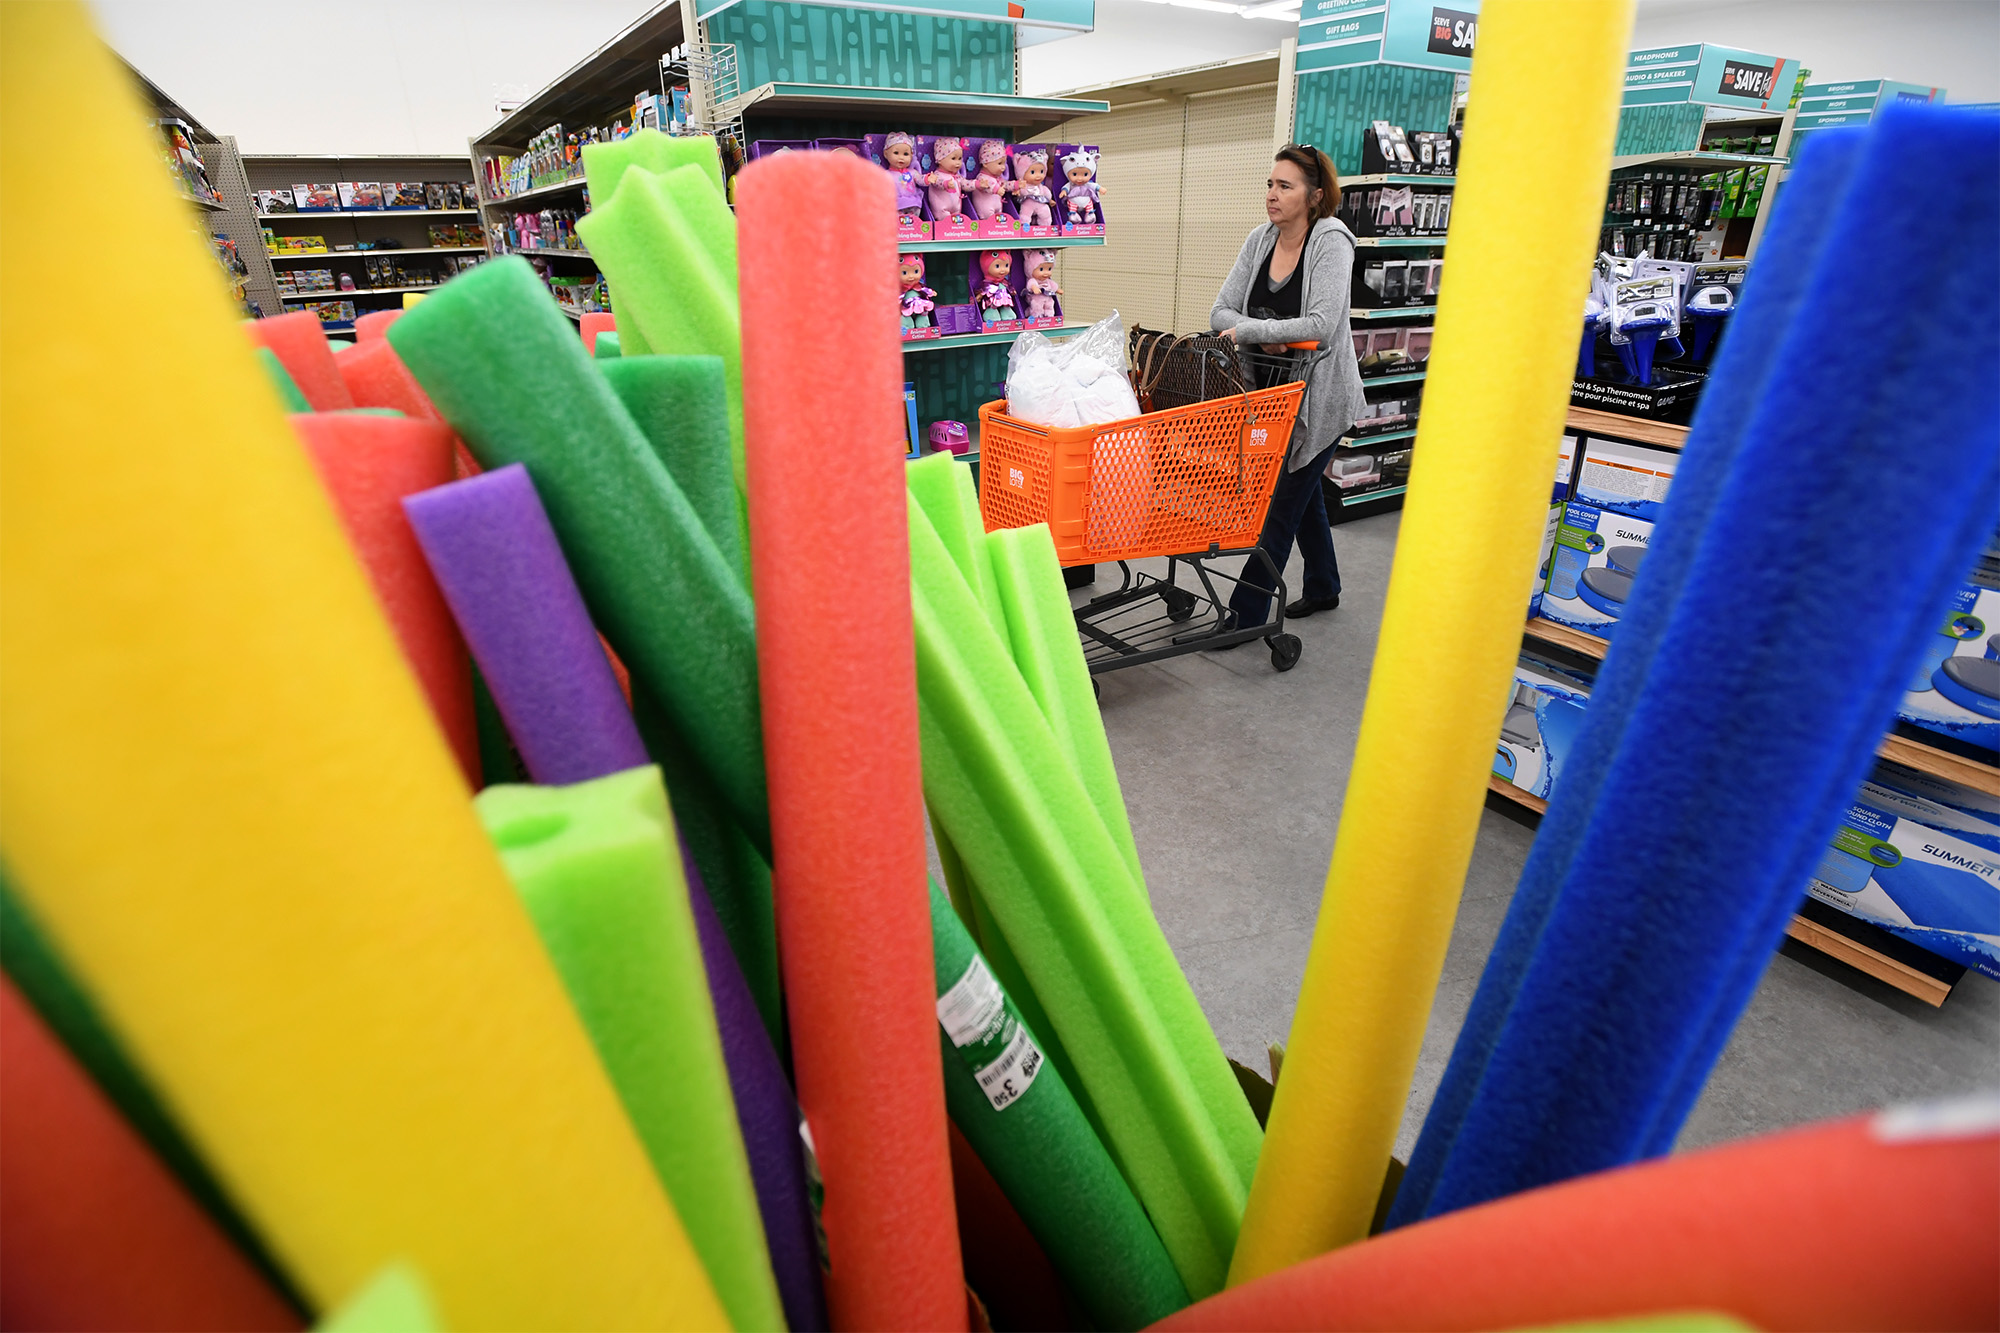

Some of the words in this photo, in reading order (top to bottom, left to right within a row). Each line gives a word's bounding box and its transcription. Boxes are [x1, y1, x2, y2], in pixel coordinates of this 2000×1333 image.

[1317, 0, 1350, 10] GREETING
[1434, 16, 1450, 27] SERVE
[1326, 24, 1340, 35] GIFT
[1341, 22, 1360, 32] BAGS
[1435, 26, 1451, 40] BIG
[1452, 20, 1477, 49] SA
[1634, 51, 1678, 61] HEADPHONES
[1625, 72, 1648, 82] AUDIO
[1653, 70, 1686, 79] SPEAKERS
[1734, 68, 1762, 92] SAVE
[1818, 116, 1846, 124] SPONGES
[1592, 384, 1605, 393] Spa
[1606, 387, 1652, 401] Thermomete
[1584, 394, 1601, 402] pour
[1602, 395, 1627, 406] piscine
[1250, 428, 1267, 438] BIG
[1010, 467, 1024, 481] BIG
[1566, 508, 1580, 516] POOL
[1581, 512, 1598, 520] COVER
[1616, 530, 1650, 544] SUMME
[1859, 785, 1897, 801] UMMER
[1852, 806, 1881, 820] SQUARE
[1846, 810, 1868, 820] OUND
[1868, 818, 1892, 830] CLOTH
[1921, 844, 1995, 876] SUMMER
